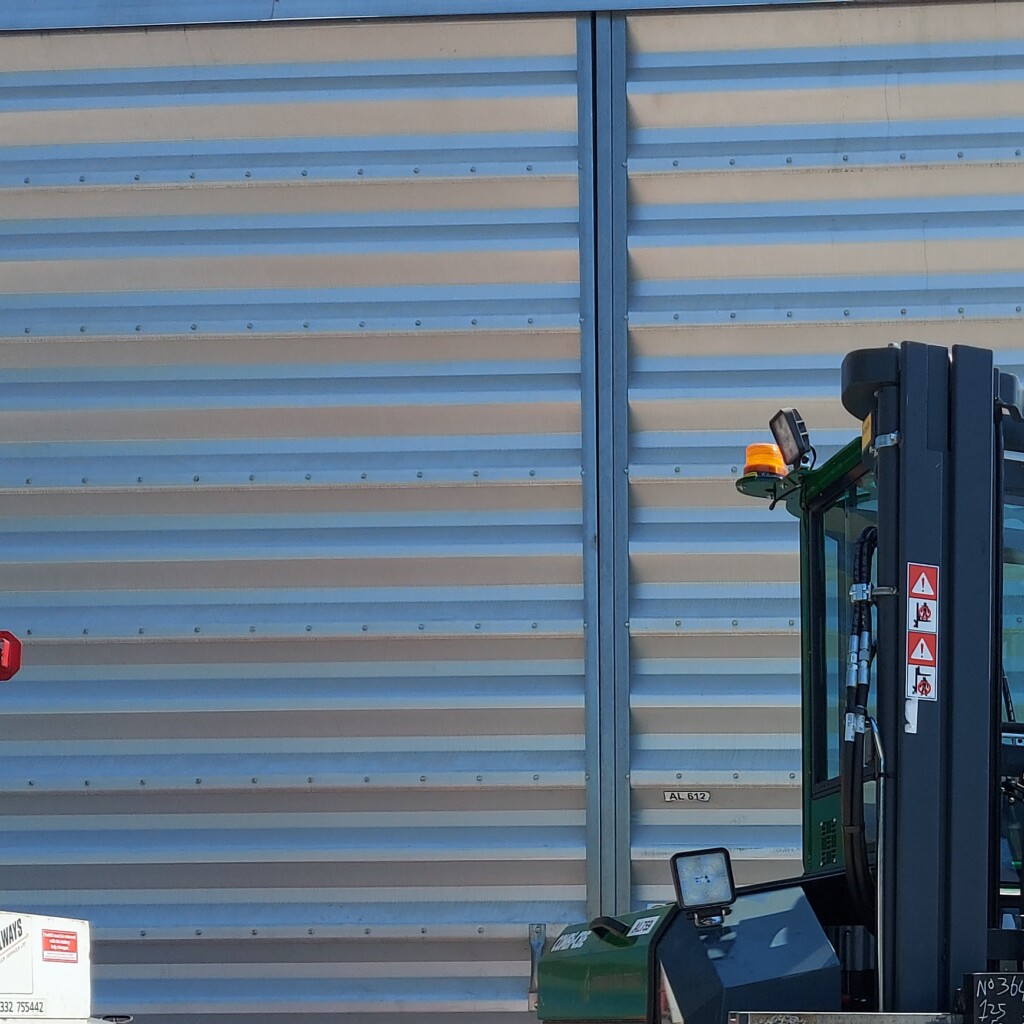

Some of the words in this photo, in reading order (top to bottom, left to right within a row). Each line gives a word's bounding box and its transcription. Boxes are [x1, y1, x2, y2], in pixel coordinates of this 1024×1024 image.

[669, 792, 685, 801] AL
[687, 792, 706, 801] 612
[0, 918, 23, 951] WAYS
[16, 1001, 44, 1013] 755442
[978, 998, 1007, 1022] 125
